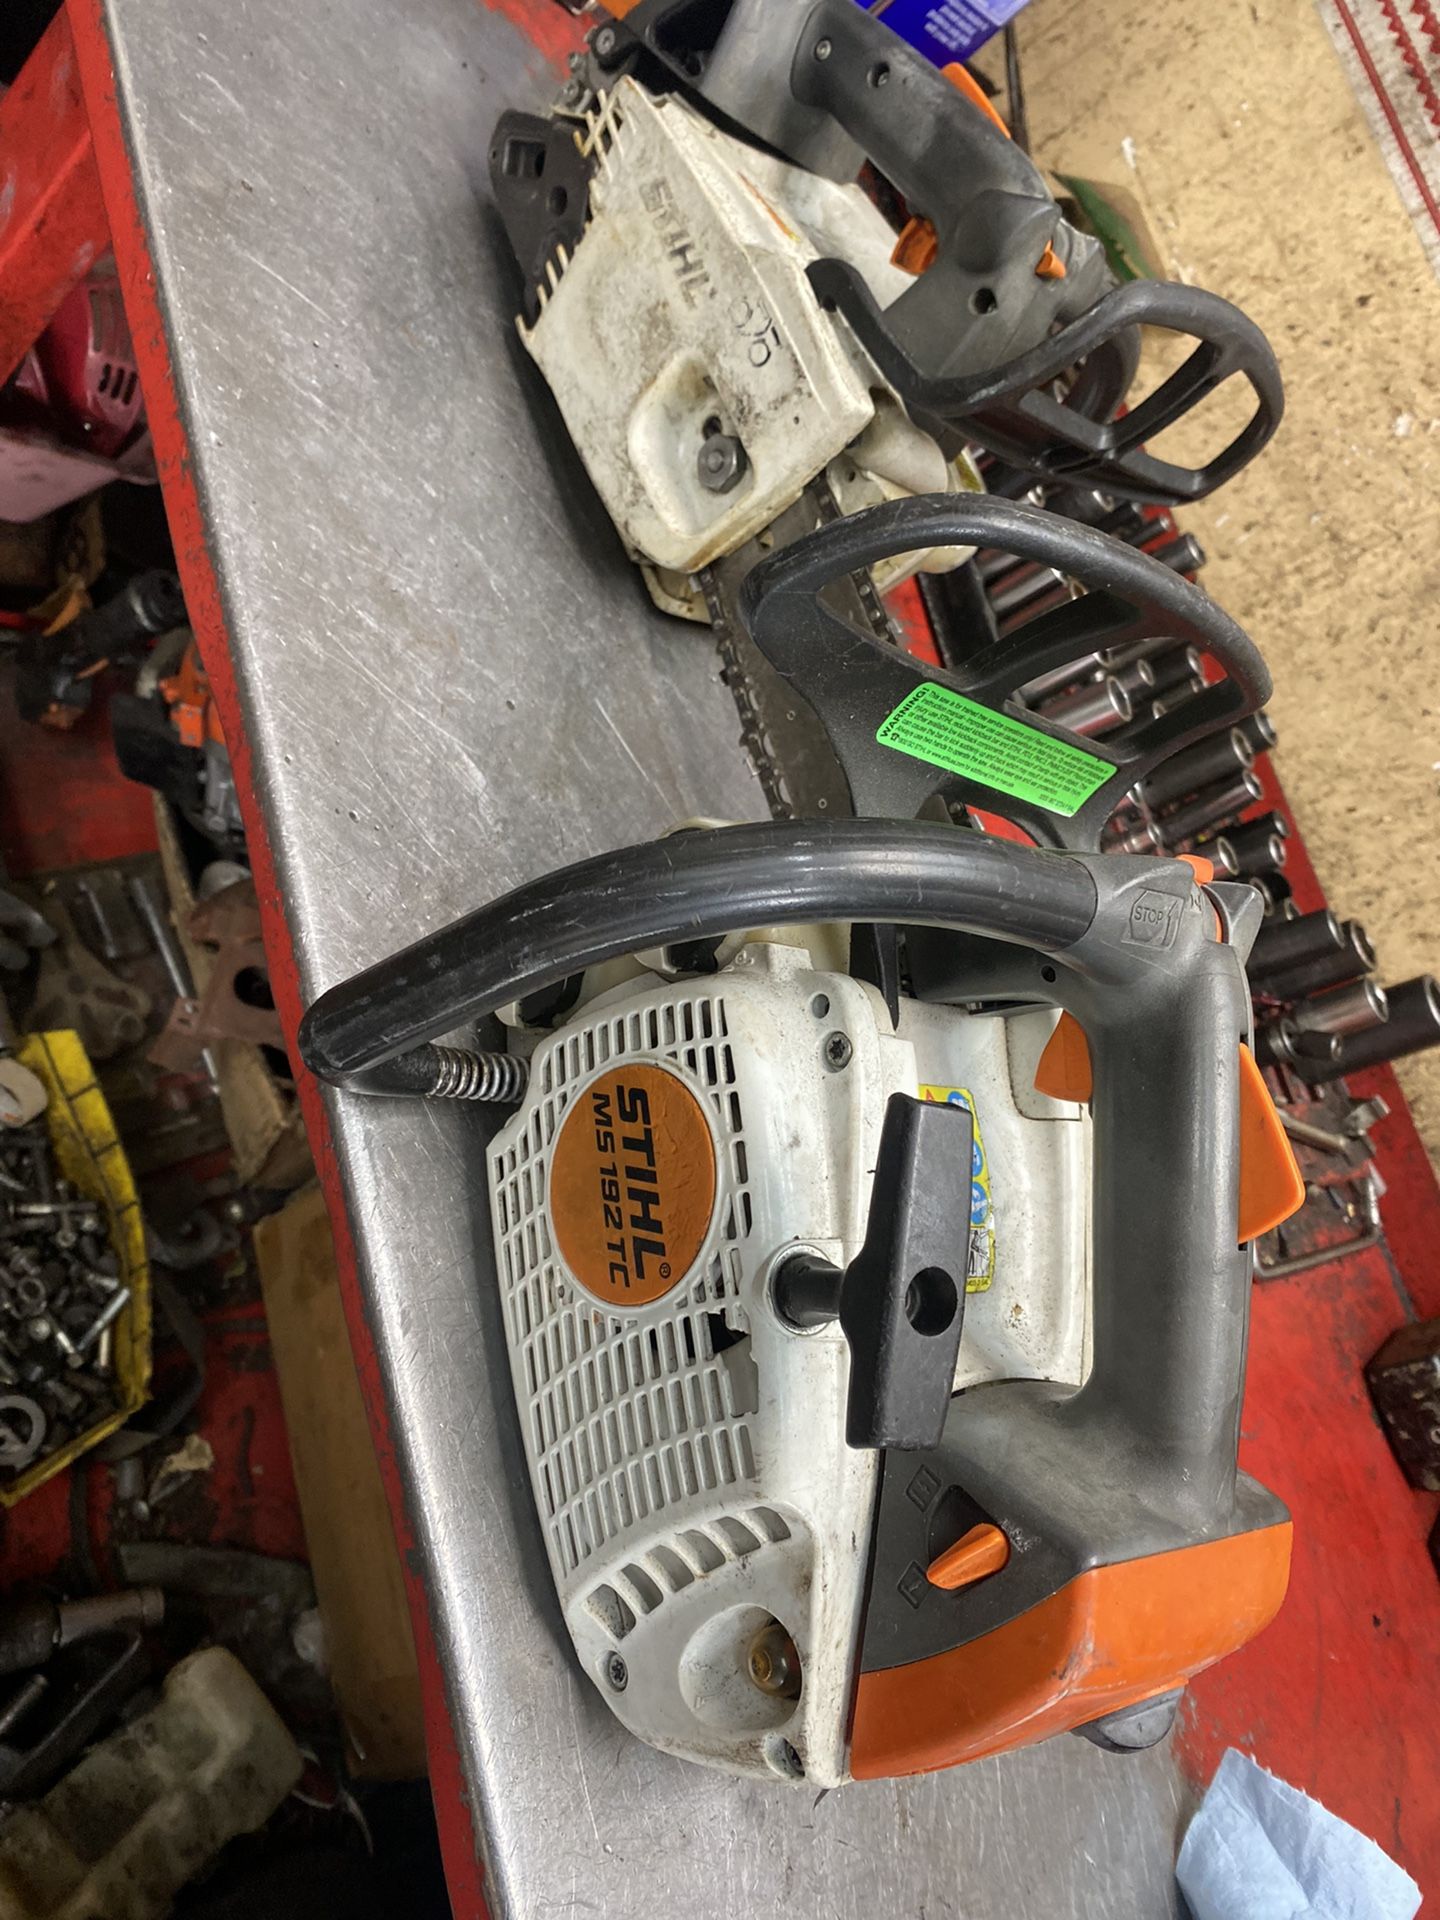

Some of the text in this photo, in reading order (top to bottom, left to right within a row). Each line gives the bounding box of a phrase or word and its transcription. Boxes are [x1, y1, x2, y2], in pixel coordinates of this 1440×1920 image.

[880, 687, 929, 737] WARNING!
[1134, 905, 1164, 925] STOP
[592, 1092, 630, 1288] MS 192 TC
[616, 1085, 667, 1279] STIHL
